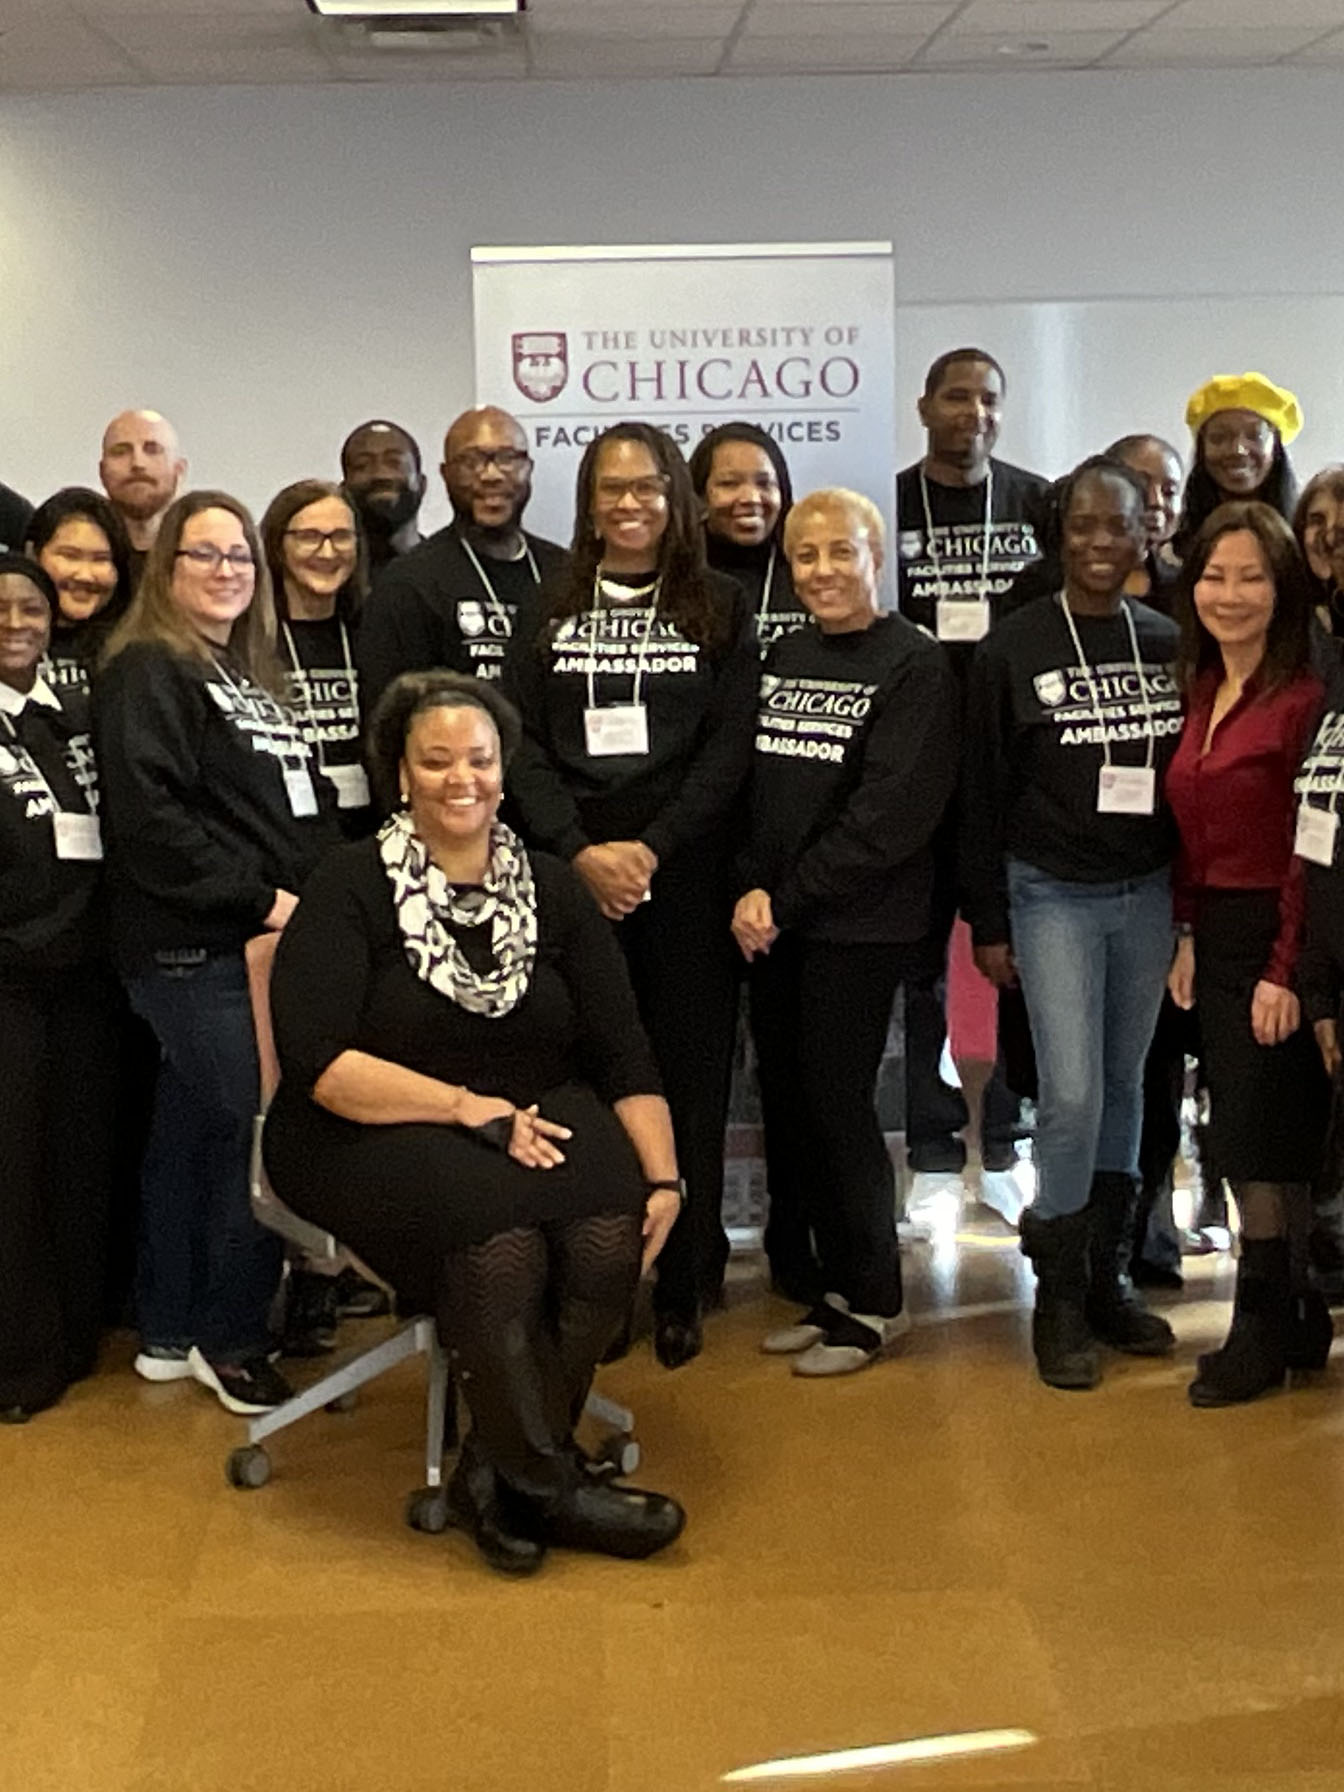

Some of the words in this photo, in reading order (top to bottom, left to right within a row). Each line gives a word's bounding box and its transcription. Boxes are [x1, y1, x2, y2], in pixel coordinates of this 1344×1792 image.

[582, 331, 637, 351] THE
[649, 327, 815, 350] UNIVERSITY
[824, 326, 861, 346] OF
[581, 356, 861, 403] CHICAGO
[926, 535, 1039, 558] CHICAGO
[552, 655, 698, 674] AMBASSADOR
[768, 690, 872, 718] CHICAGO
[1059, 716, 1185, 745] AMBASSADO
